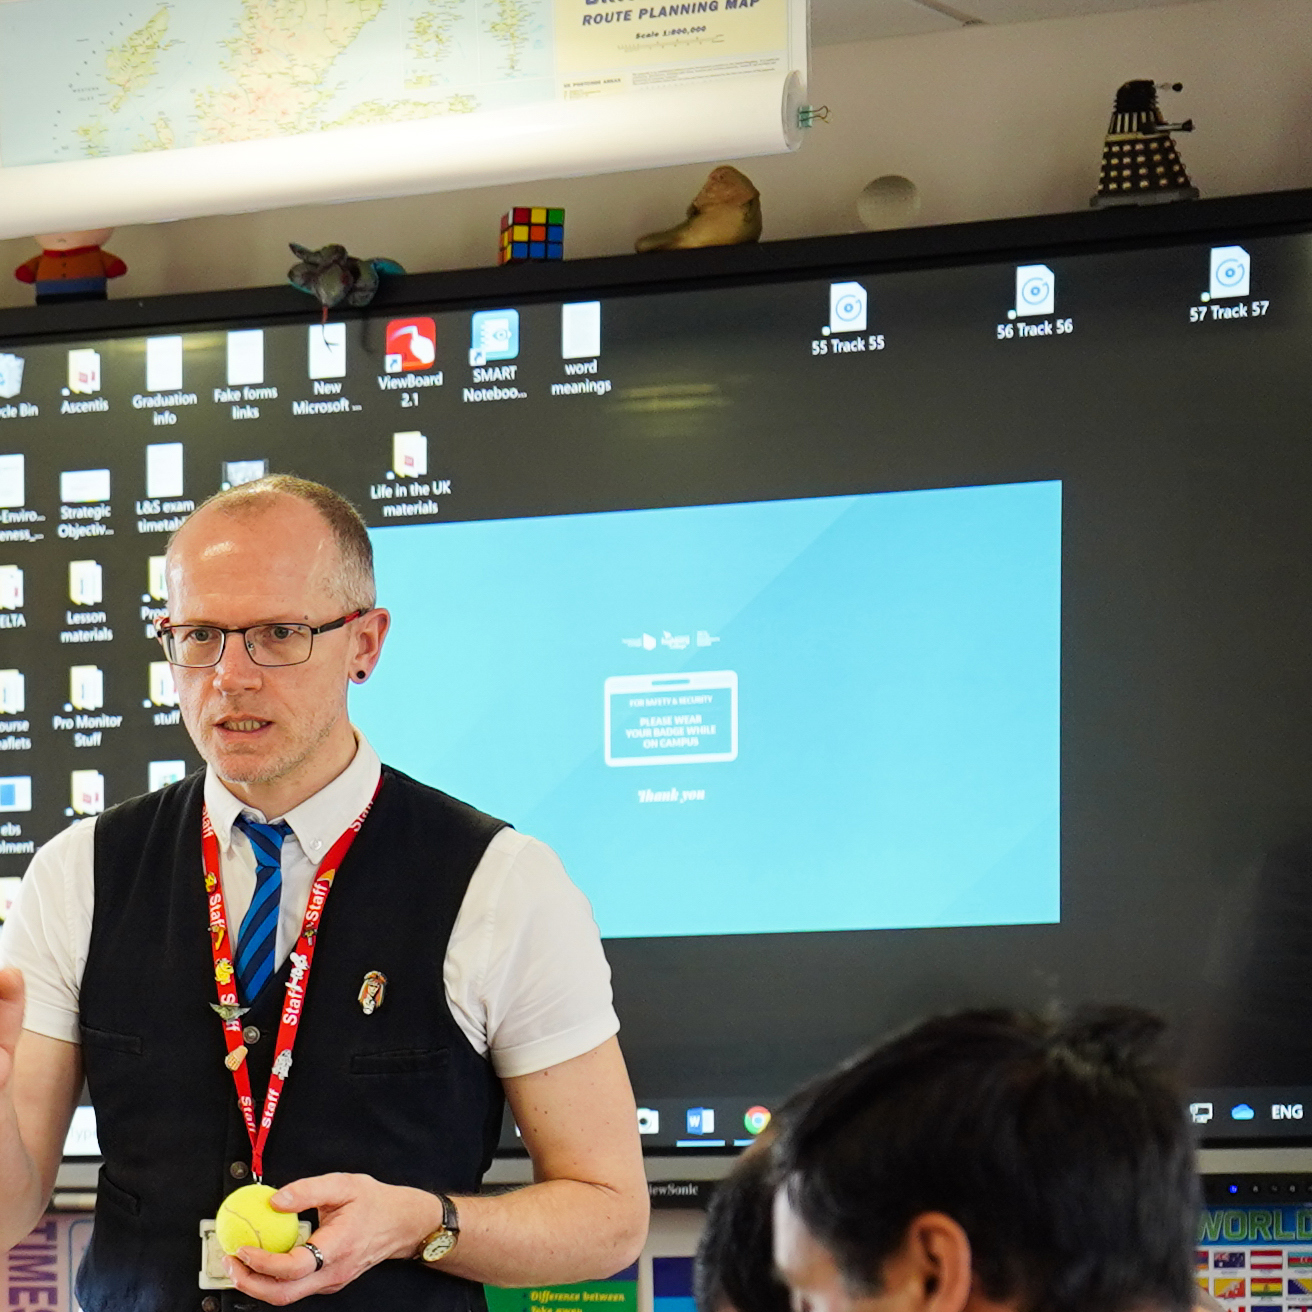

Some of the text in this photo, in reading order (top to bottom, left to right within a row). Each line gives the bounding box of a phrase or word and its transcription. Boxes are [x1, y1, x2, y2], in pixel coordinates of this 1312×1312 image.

[582, 9, 633, 26] ROUTE
[638, 0, 719, 20] PLANNING
[635, 31, 659, 40] Scale
[1189, 300, 1270, 322] 57 Track 57
[996, 318, 1074, 340] 56 Track 56
[811, 334, 885, 355] 55 Track 55
[473, 365, 518, 383] SMART
[565, 359, 598, 375] word
[314, 381, 342, 395] New
[378, 371, 444, 390] ViewBoard
[551, 378, 612, 397] meanings
[133, 392, 197, 409] Graduation
[214, 386, 278, 403] Fake forms
[401, 393, 419, 408] 2.1
[19, 403, 39, 418] Bin
[61, 398, 109, 414] Ascentis
[232, 405, 260, 420] links
[292, 398, 349, 415] Microsoft
[153, 411, 177, 425] info
[370, 480, 452, 500] Life in the UK
[61, 504, 111, 521] Strategic
[162, 500, 195, 513] exam
[383, 500, 439, 517] materials
[66, 610, 106, 625] Lesson
[60, 626, 113, 643] materials
[52, 713, 123, 730] Pro Monitor
[154, 710, 181, 726] stuff
[640, 714, 702, 727] PLEASE WEAR
[74, 731, 102, 748] Stuff
[626, 725, 716, 738] YOUR BADGE WHILE
[643, 736, 699, 749] ON CAMPUS
[638, 787, 705, 804] Thank you
[0, 821, 22, 837] ebs
[305, 883, 329, 922] Staff
[240, 1096, 257, 1135] Staff
[262, 1088, 279, 1129] Staff
[1271, 1104, 1304, 1120] ENG
[530, 1291, 625, 1304] Difference between
